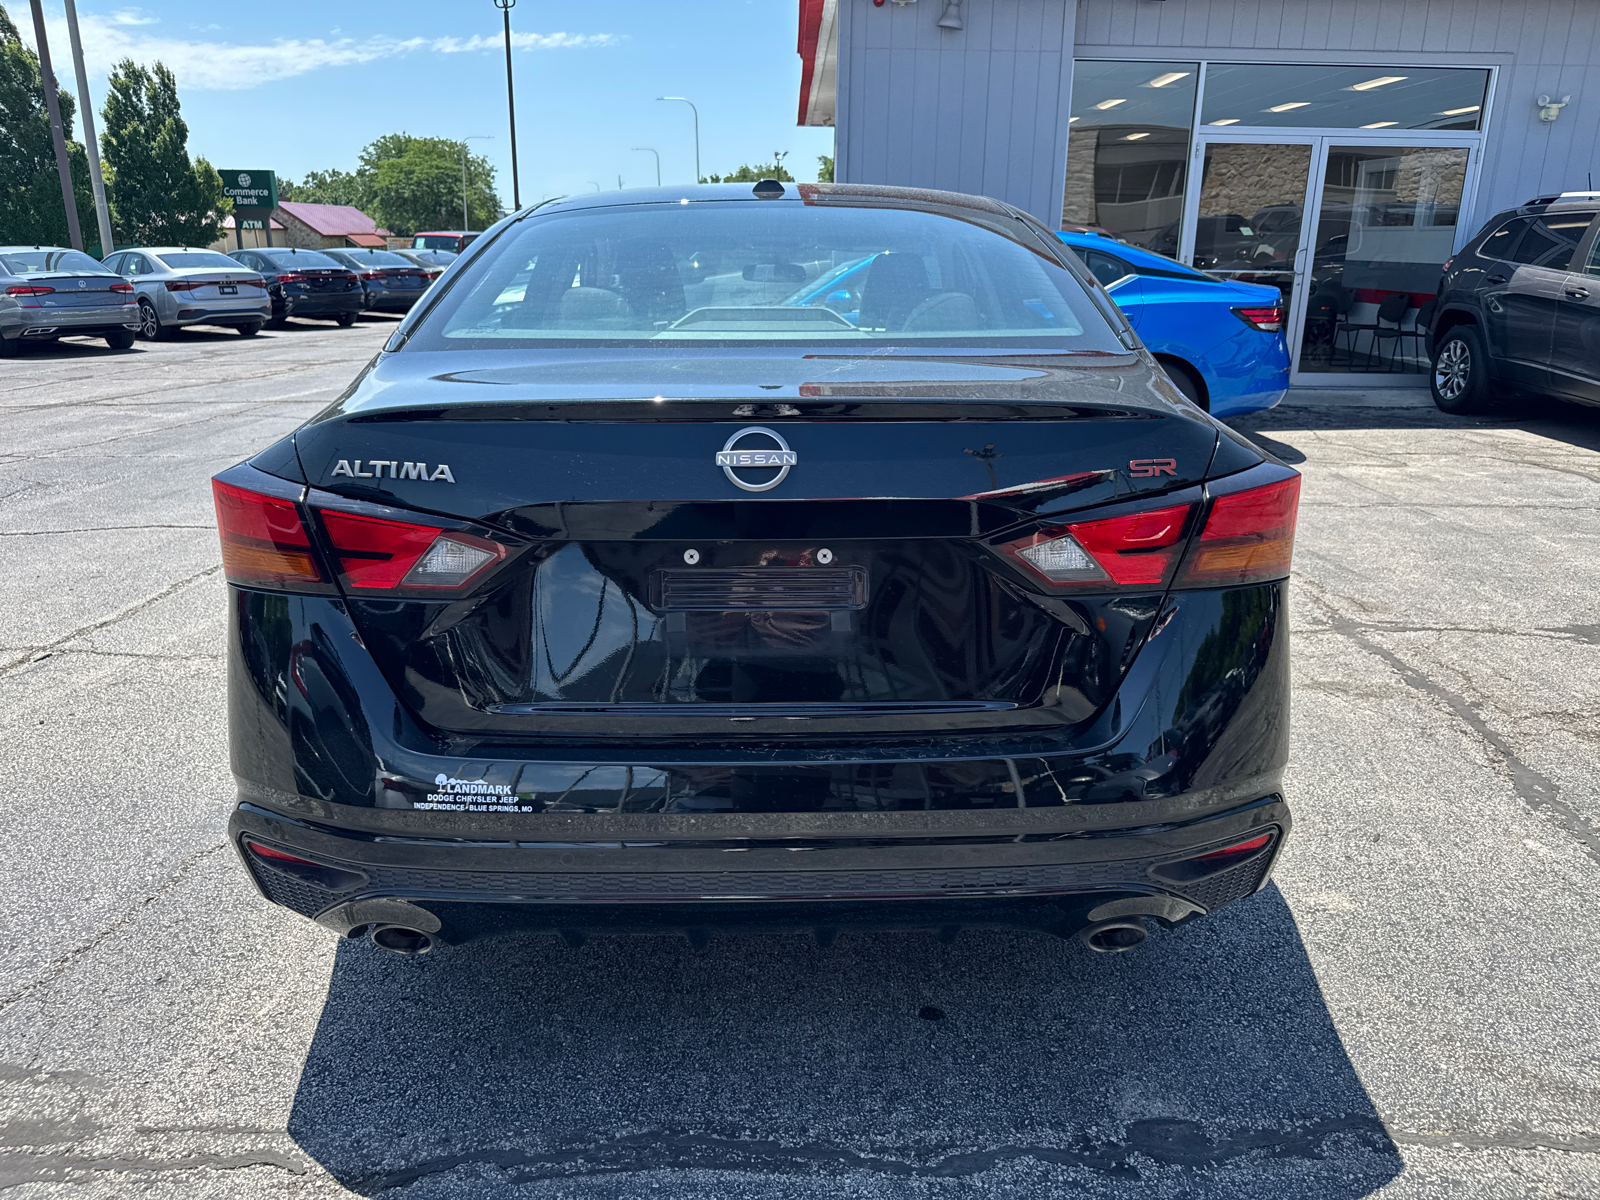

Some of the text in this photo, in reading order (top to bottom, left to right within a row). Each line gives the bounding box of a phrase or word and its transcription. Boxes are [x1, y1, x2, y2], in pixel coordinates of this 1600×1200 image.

[223, 187, 269, 196] Commerce
[236, 196, 258, 205] Bank
[242, 220, 263, 229] ATM
[718, 454, 795, 465] NISSAN
[331, 459, 456, 484] ALTIMA
[1129, 458, 1178, 478] SR
[446, 783, 512, 795] LANDMARK
[427, 793, 519, 804] DODGE CHRYSLER JEEP
[413, 802, 533, 813] INDEPENDENCE BLUE SPRINGS, MO
